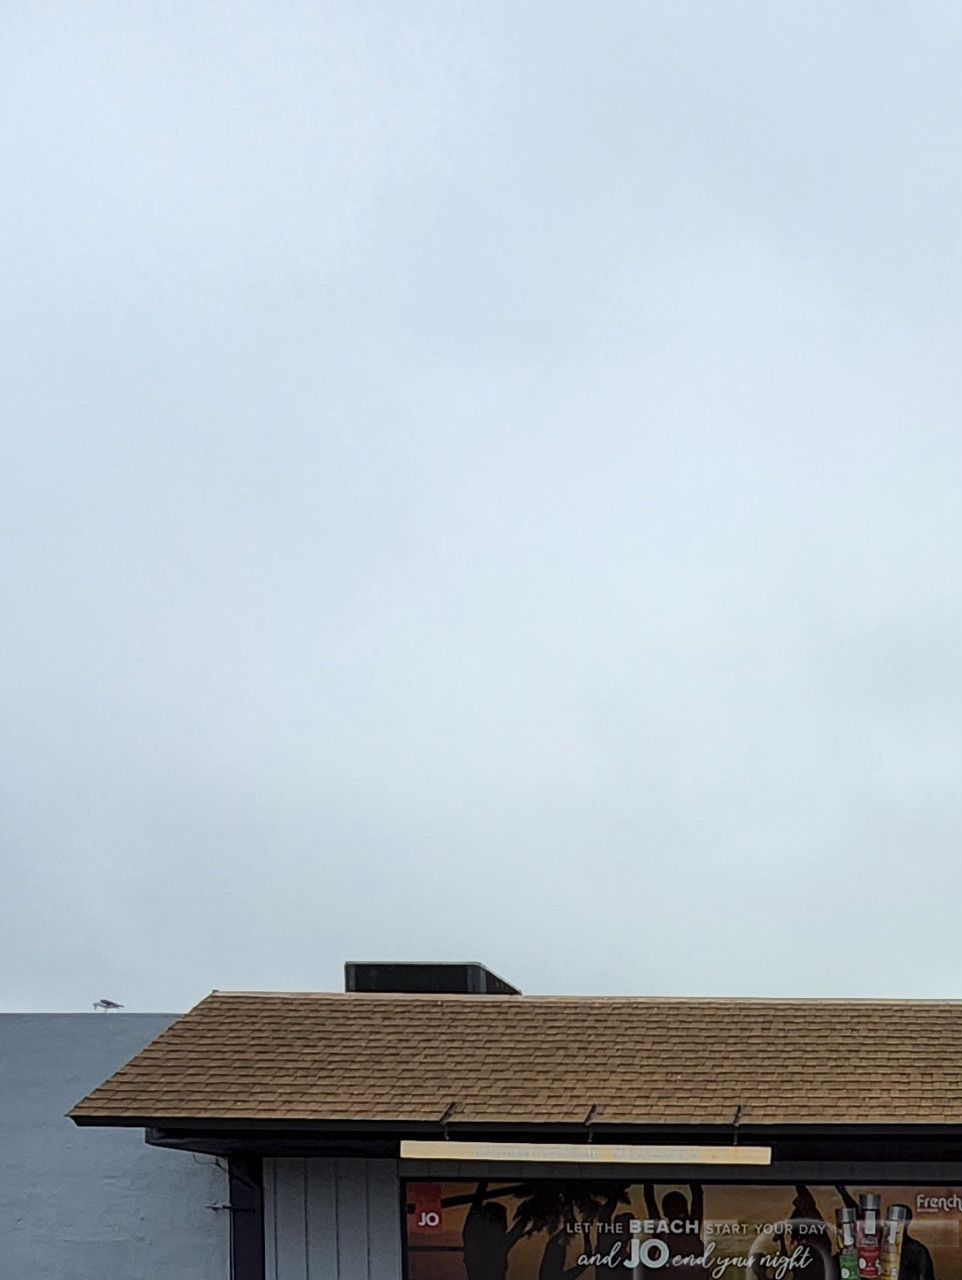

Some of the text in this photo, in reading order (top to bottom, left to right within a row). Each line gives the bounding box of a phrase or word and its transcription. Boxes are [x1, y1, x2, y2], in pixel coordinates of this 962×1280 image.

[418, 1212, 440, 1227] JO
[566, 1219, 827, 1236] LET THE BEACH START YOUR DAY
[577, 1241, 622, 1268] and
[672, 1241, 716, 1268] end
[712, 1256, 755, 1280] your
[759, 1244, 814, 1280] night
